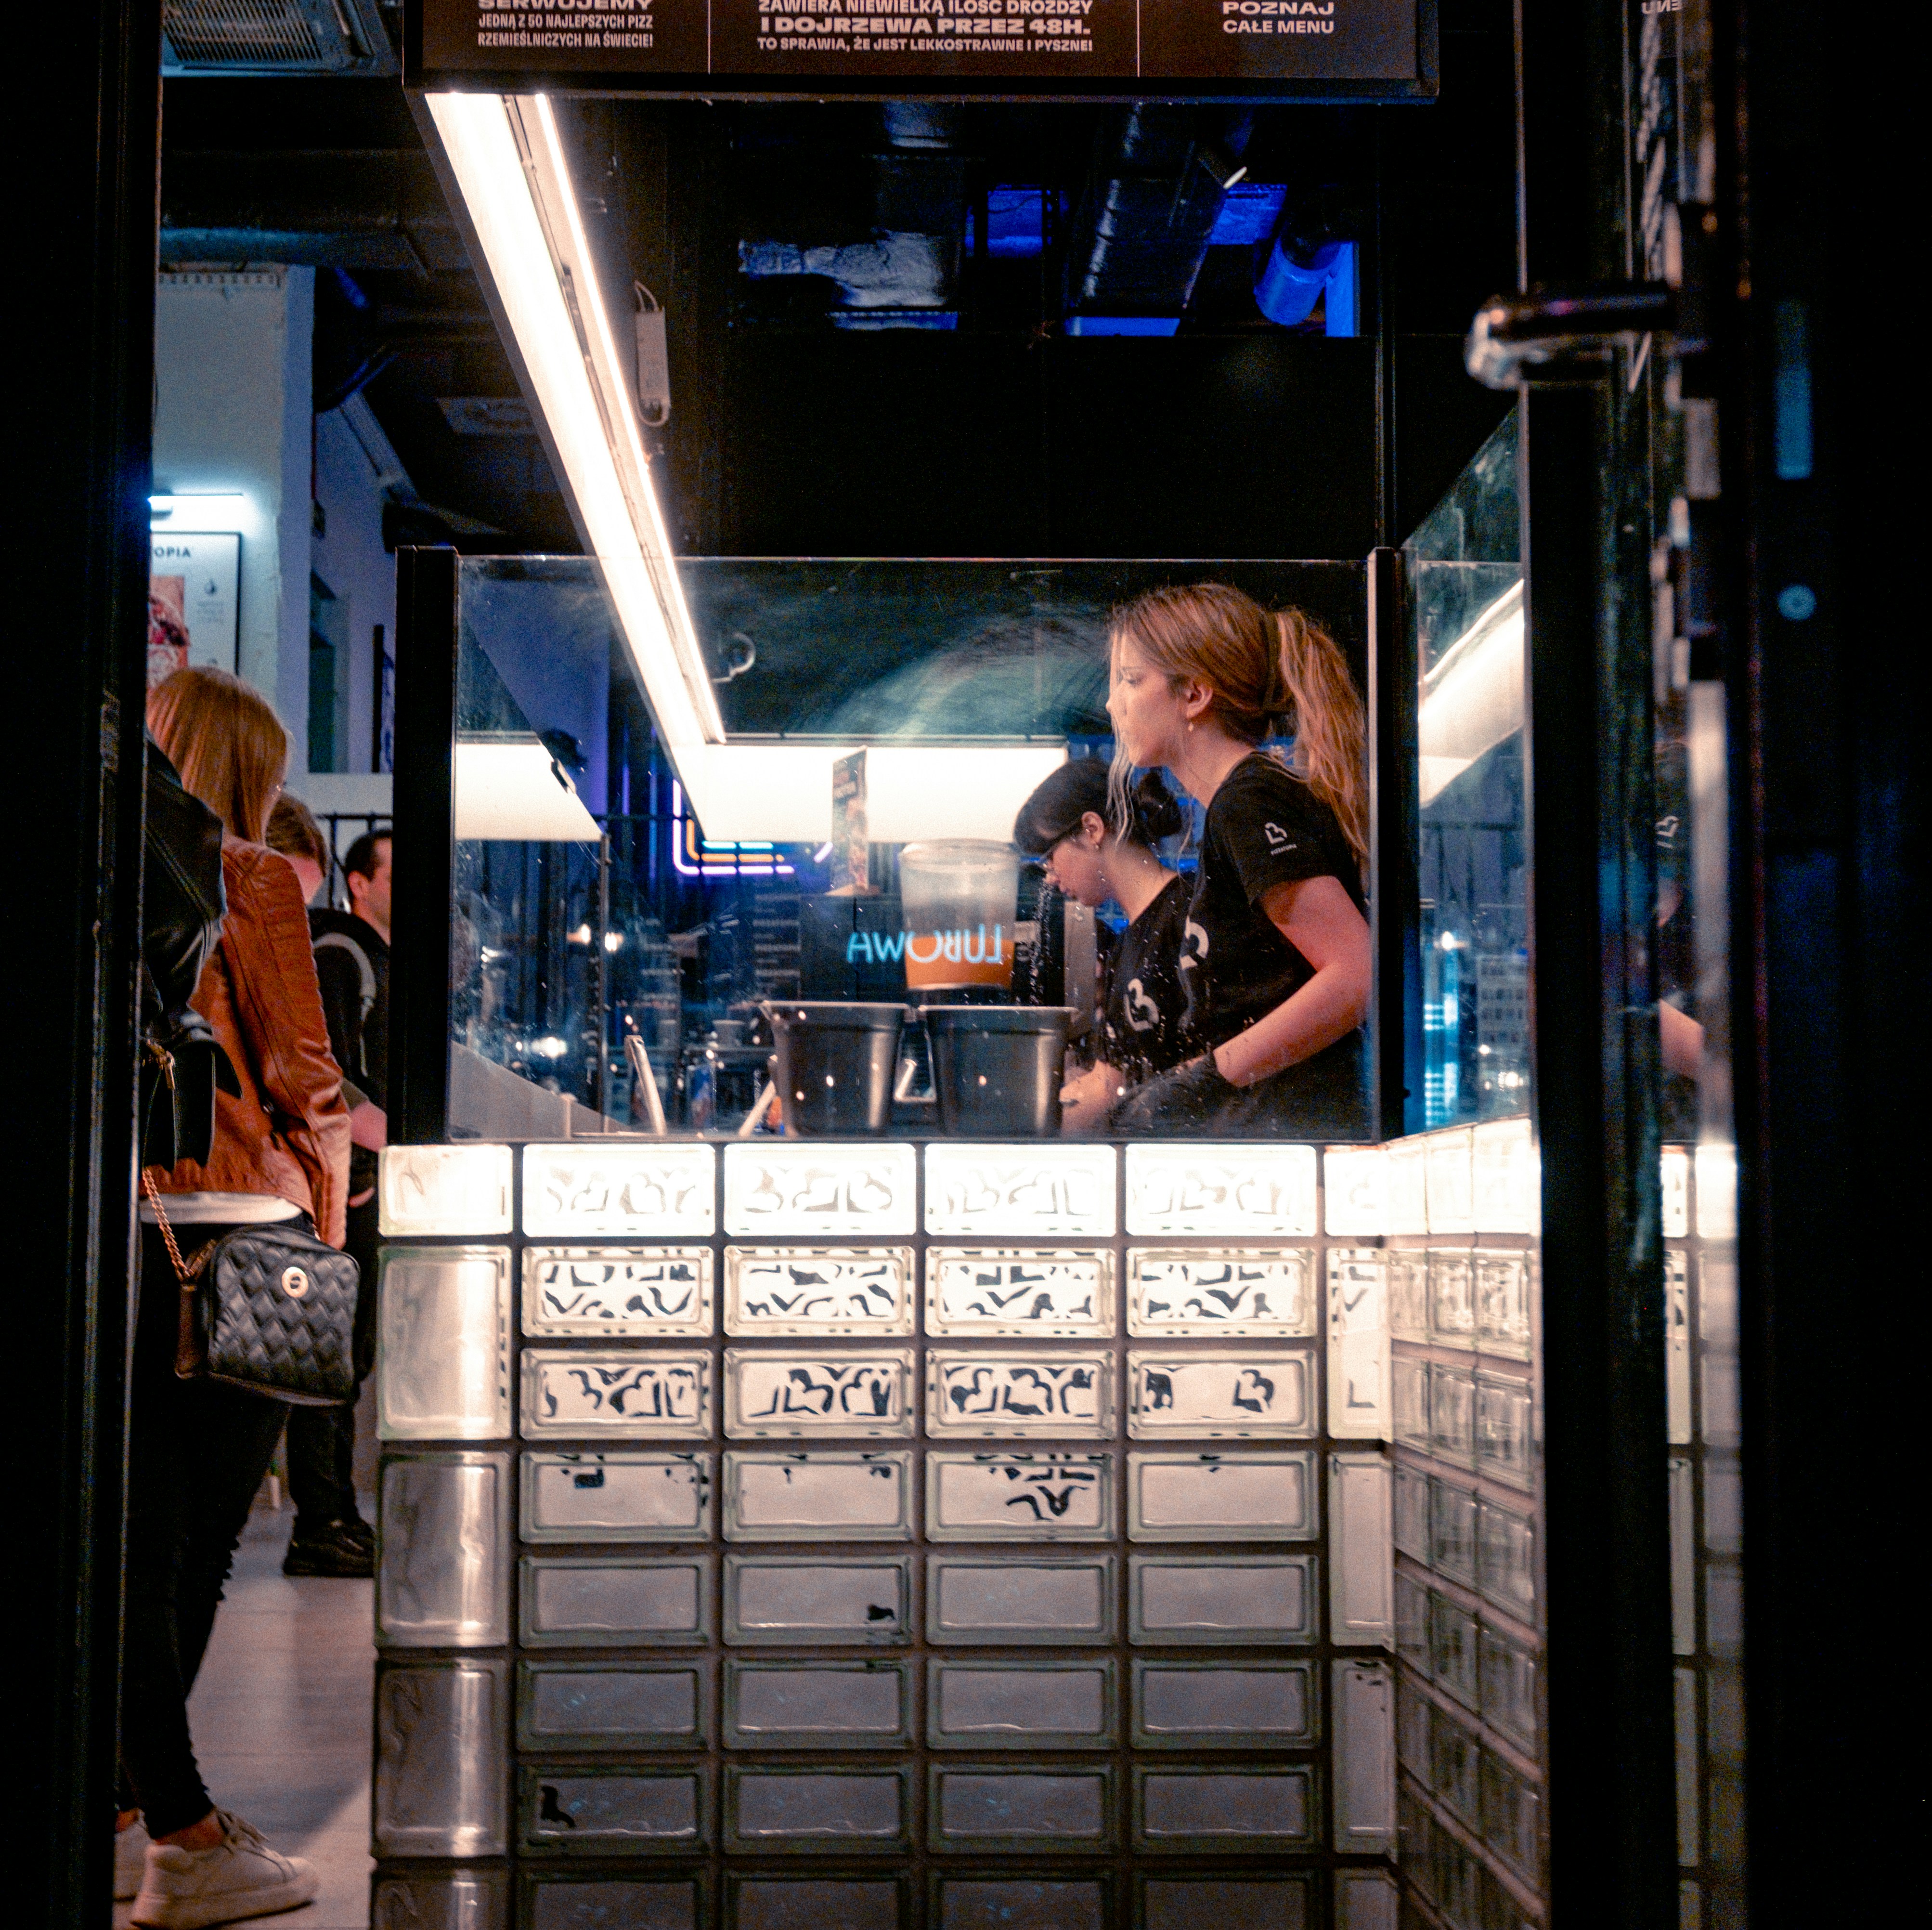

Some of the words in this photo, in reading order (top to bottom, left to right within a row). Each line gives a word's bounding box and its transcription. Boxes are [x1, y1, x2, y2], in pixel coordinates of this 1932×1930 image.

[479, 0, 652, 10] SERWUJEMY
[759, 0, 843, 13] ZAWIERA
[846, 0, 945, 16] NIEWIELKĄ
[1223, 1, 1334, 15] POZNAJ
[479, 13, 516, 30] JEDNĄ
[519, 15, 526, 28] Z
[528, 14, 543, 28] 50
[546, 14, 625, 29] NAJLEPSZYCH
[628, 15, 653, 29] PIZZ
[761, 18, 769, 33] I
[775, 18, 933, 34] DOJRZEWA
[937, 18, 1024, 34] PRZEZ
[1029, 19, 1091, 35] 48H.
[1223, 20, 1273, 34] CAŁE
[1278, 20, 1334, 34] MENU
[478, 31, 582, 47] RZEMIEŚLNICZYCH
[585, 33, 601, 47] NA
[603, 31, 653, 48] ŚWIECIE!
[757, 38, 778, 50] TO
[780, 38, 850, 52] SPRAWIA,
[854, 36, 870, 51] ŻE
[873, 39, 908, 51] JEST
[910, 39, 1024, 52] LEKKOSTRAWNE
[1027, 39, 1032, 51] I
[1035, 39, 1093, 52] PYSZNE!
